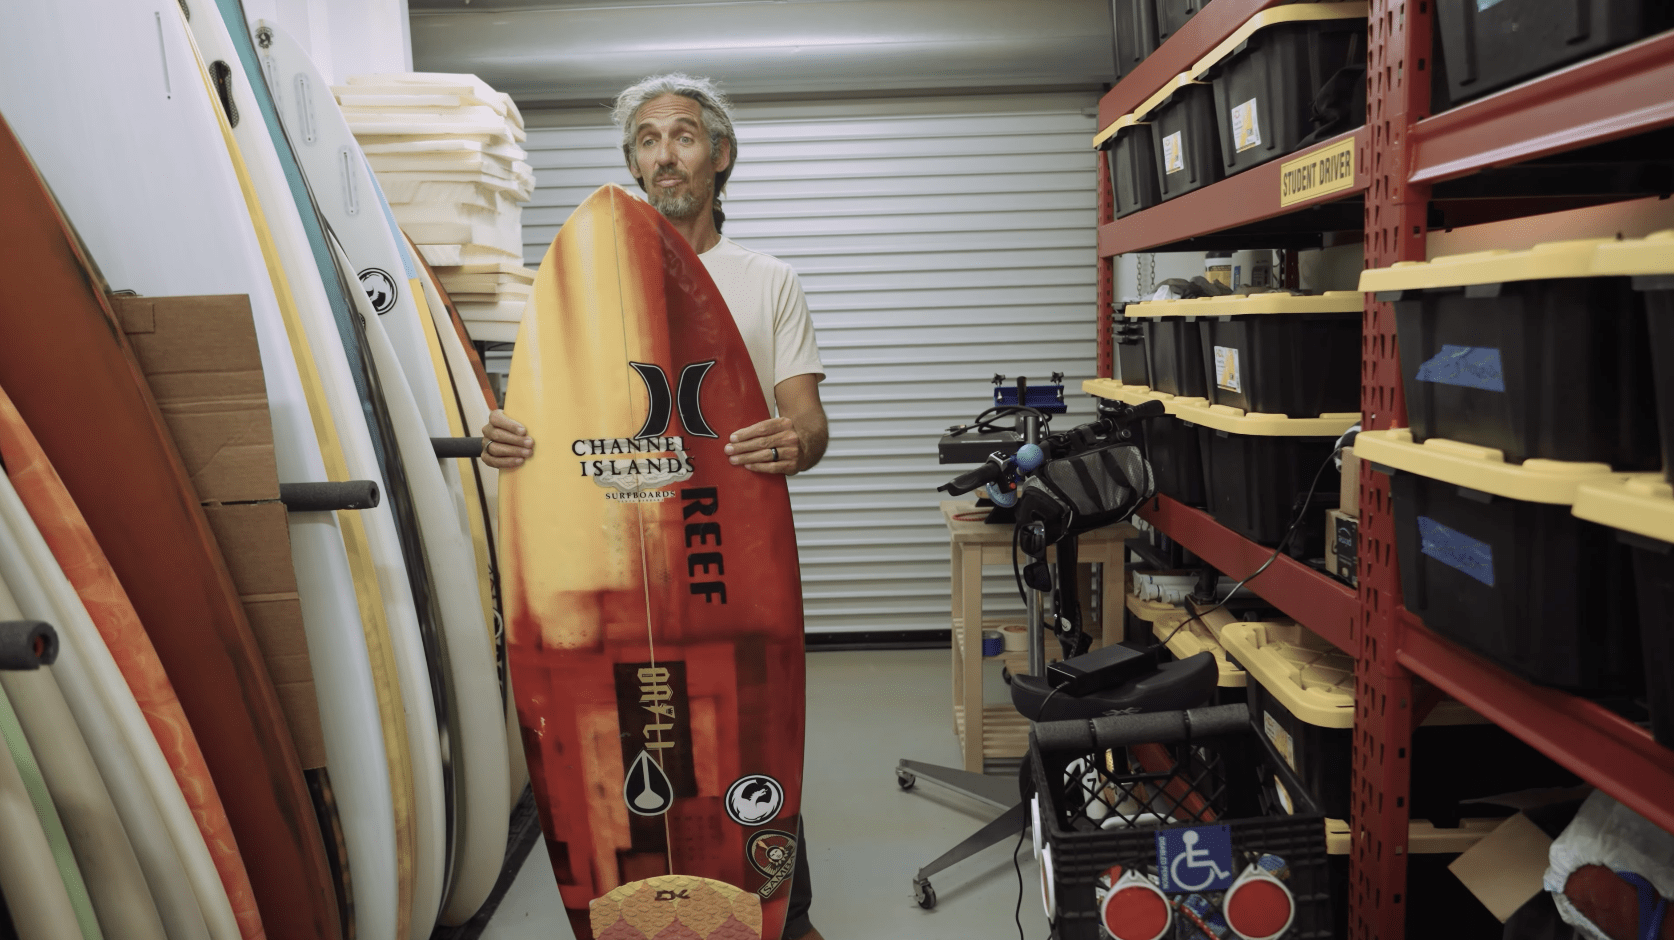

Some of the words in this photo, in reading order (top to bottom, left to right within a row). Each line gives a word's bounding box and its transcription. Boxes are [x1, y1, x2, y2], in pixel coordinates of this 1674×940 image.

[1283, 162, 1317, 197] STUDENT
[1319, 150, 1351, 186] DRIVER
[571, 436, 691, 456] CHANNEL
[580, 456, 694, 477] ISLANDS
[605, 491, 676, 500] SURFBOARDS
[681, 487, 727, 604] REEF
